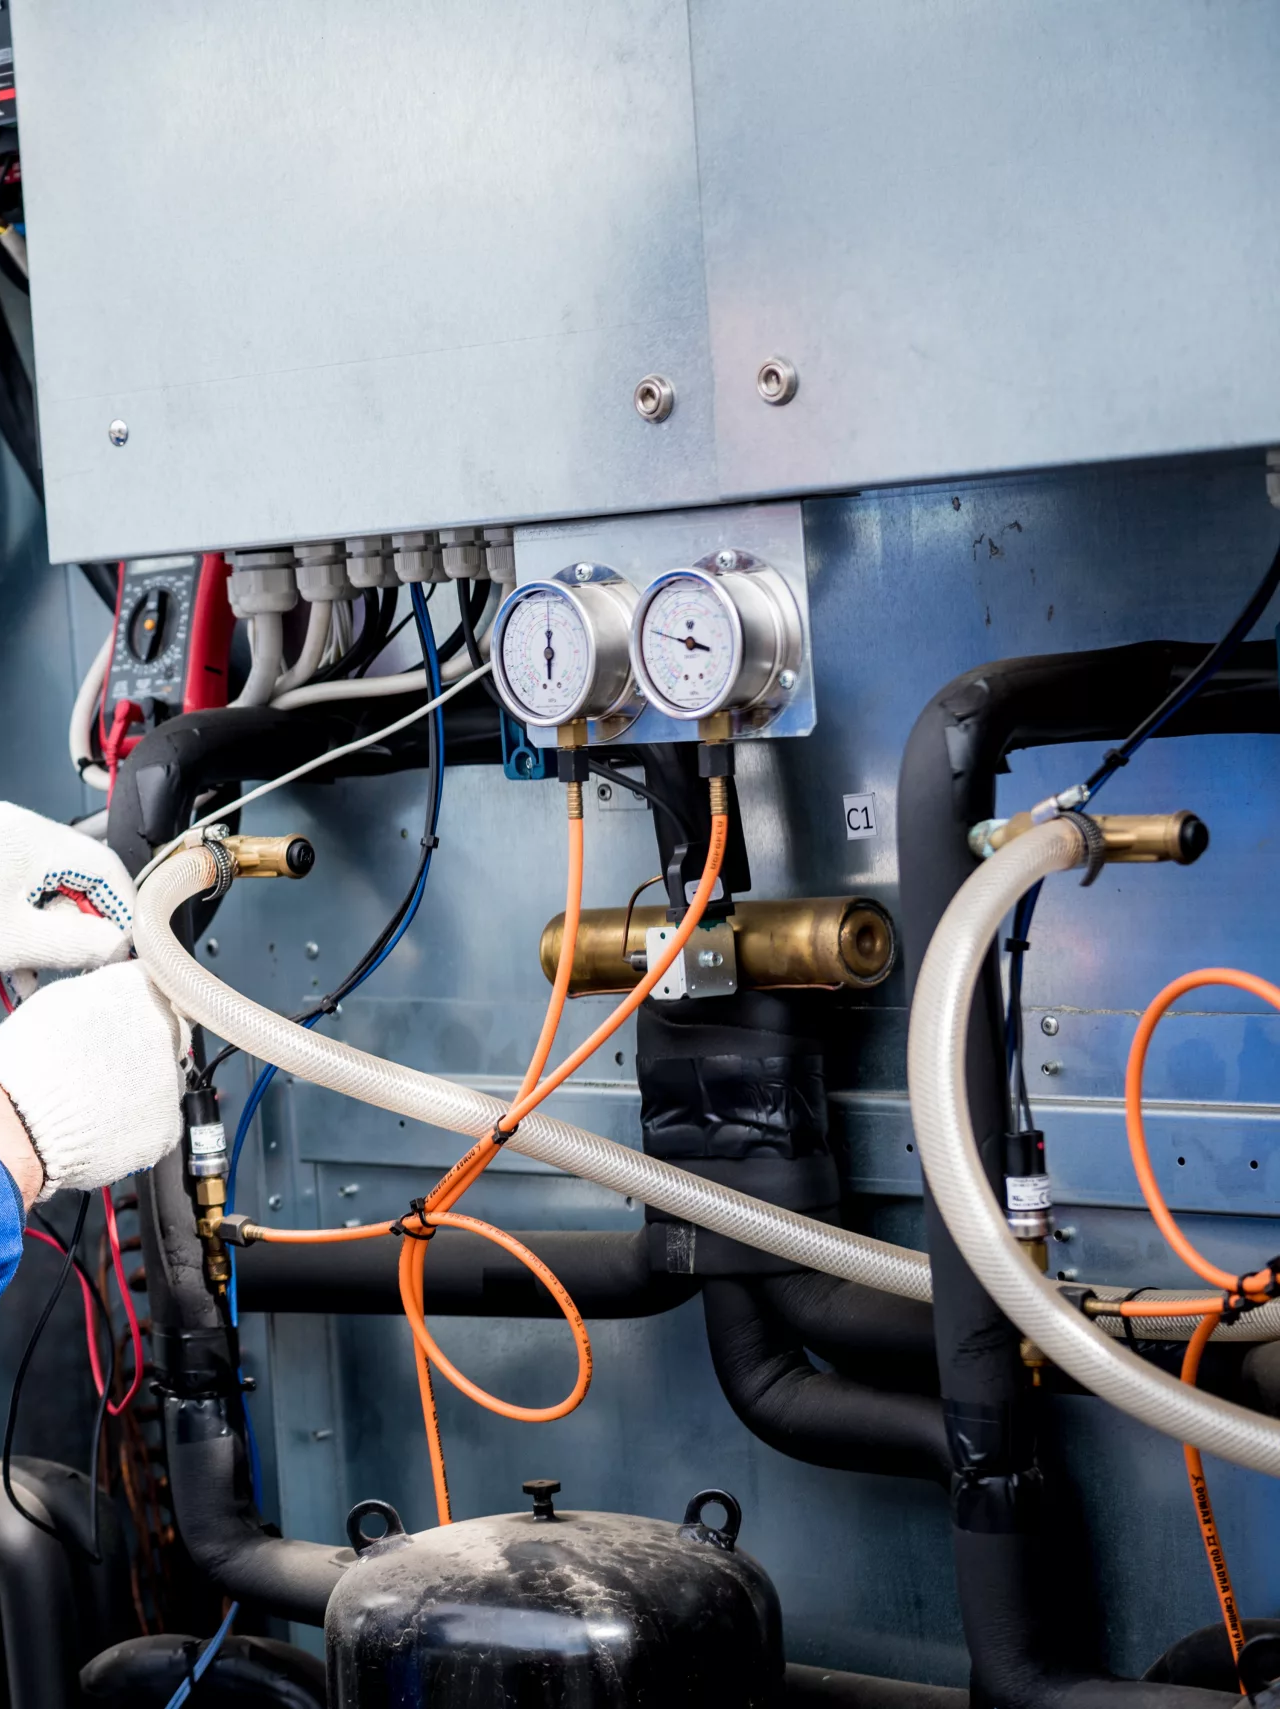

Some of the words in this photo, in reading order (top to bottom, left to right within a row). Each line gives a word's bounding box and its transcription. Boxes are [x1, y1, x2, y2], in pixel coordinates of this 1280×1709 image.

[847, 805, 874, 831] C1
[549, 1274, 558, 1285] to
[574, 1315, 583, 1328] TS
[1195, 1486, 1212, 1525] DOMAX
[1210, 1549, 1230, 1594] QUADRA
[1223, 1596, 1241, 1639] Capillary
